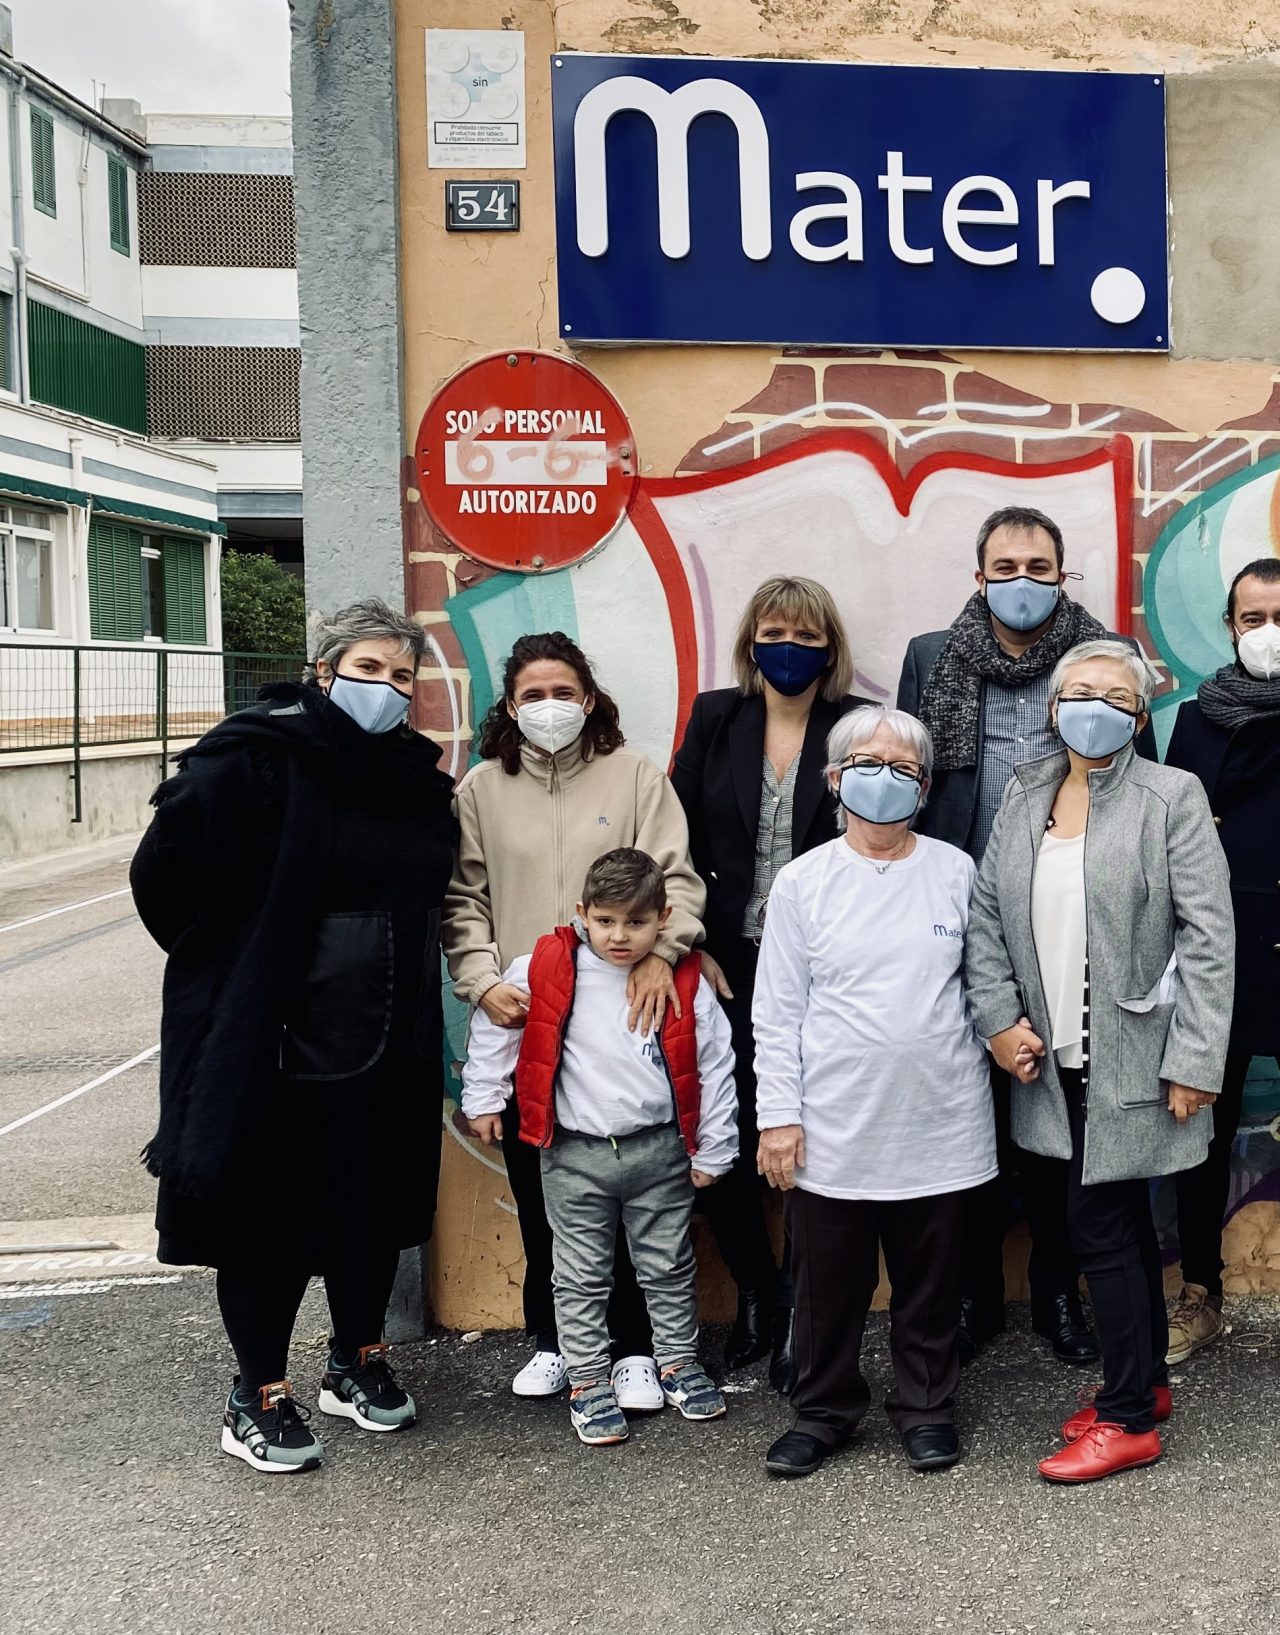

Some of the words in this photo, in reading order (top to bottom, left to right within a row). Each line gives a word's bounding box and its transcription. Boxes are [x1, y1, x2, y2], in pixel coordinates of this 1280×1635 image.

[472, 76, 488, 87] sin
[457, 189, 509, 222] 54
[504, 409, 606, 434] PERSONAL
[458, 490, 597, 515] AUTORIZADO
